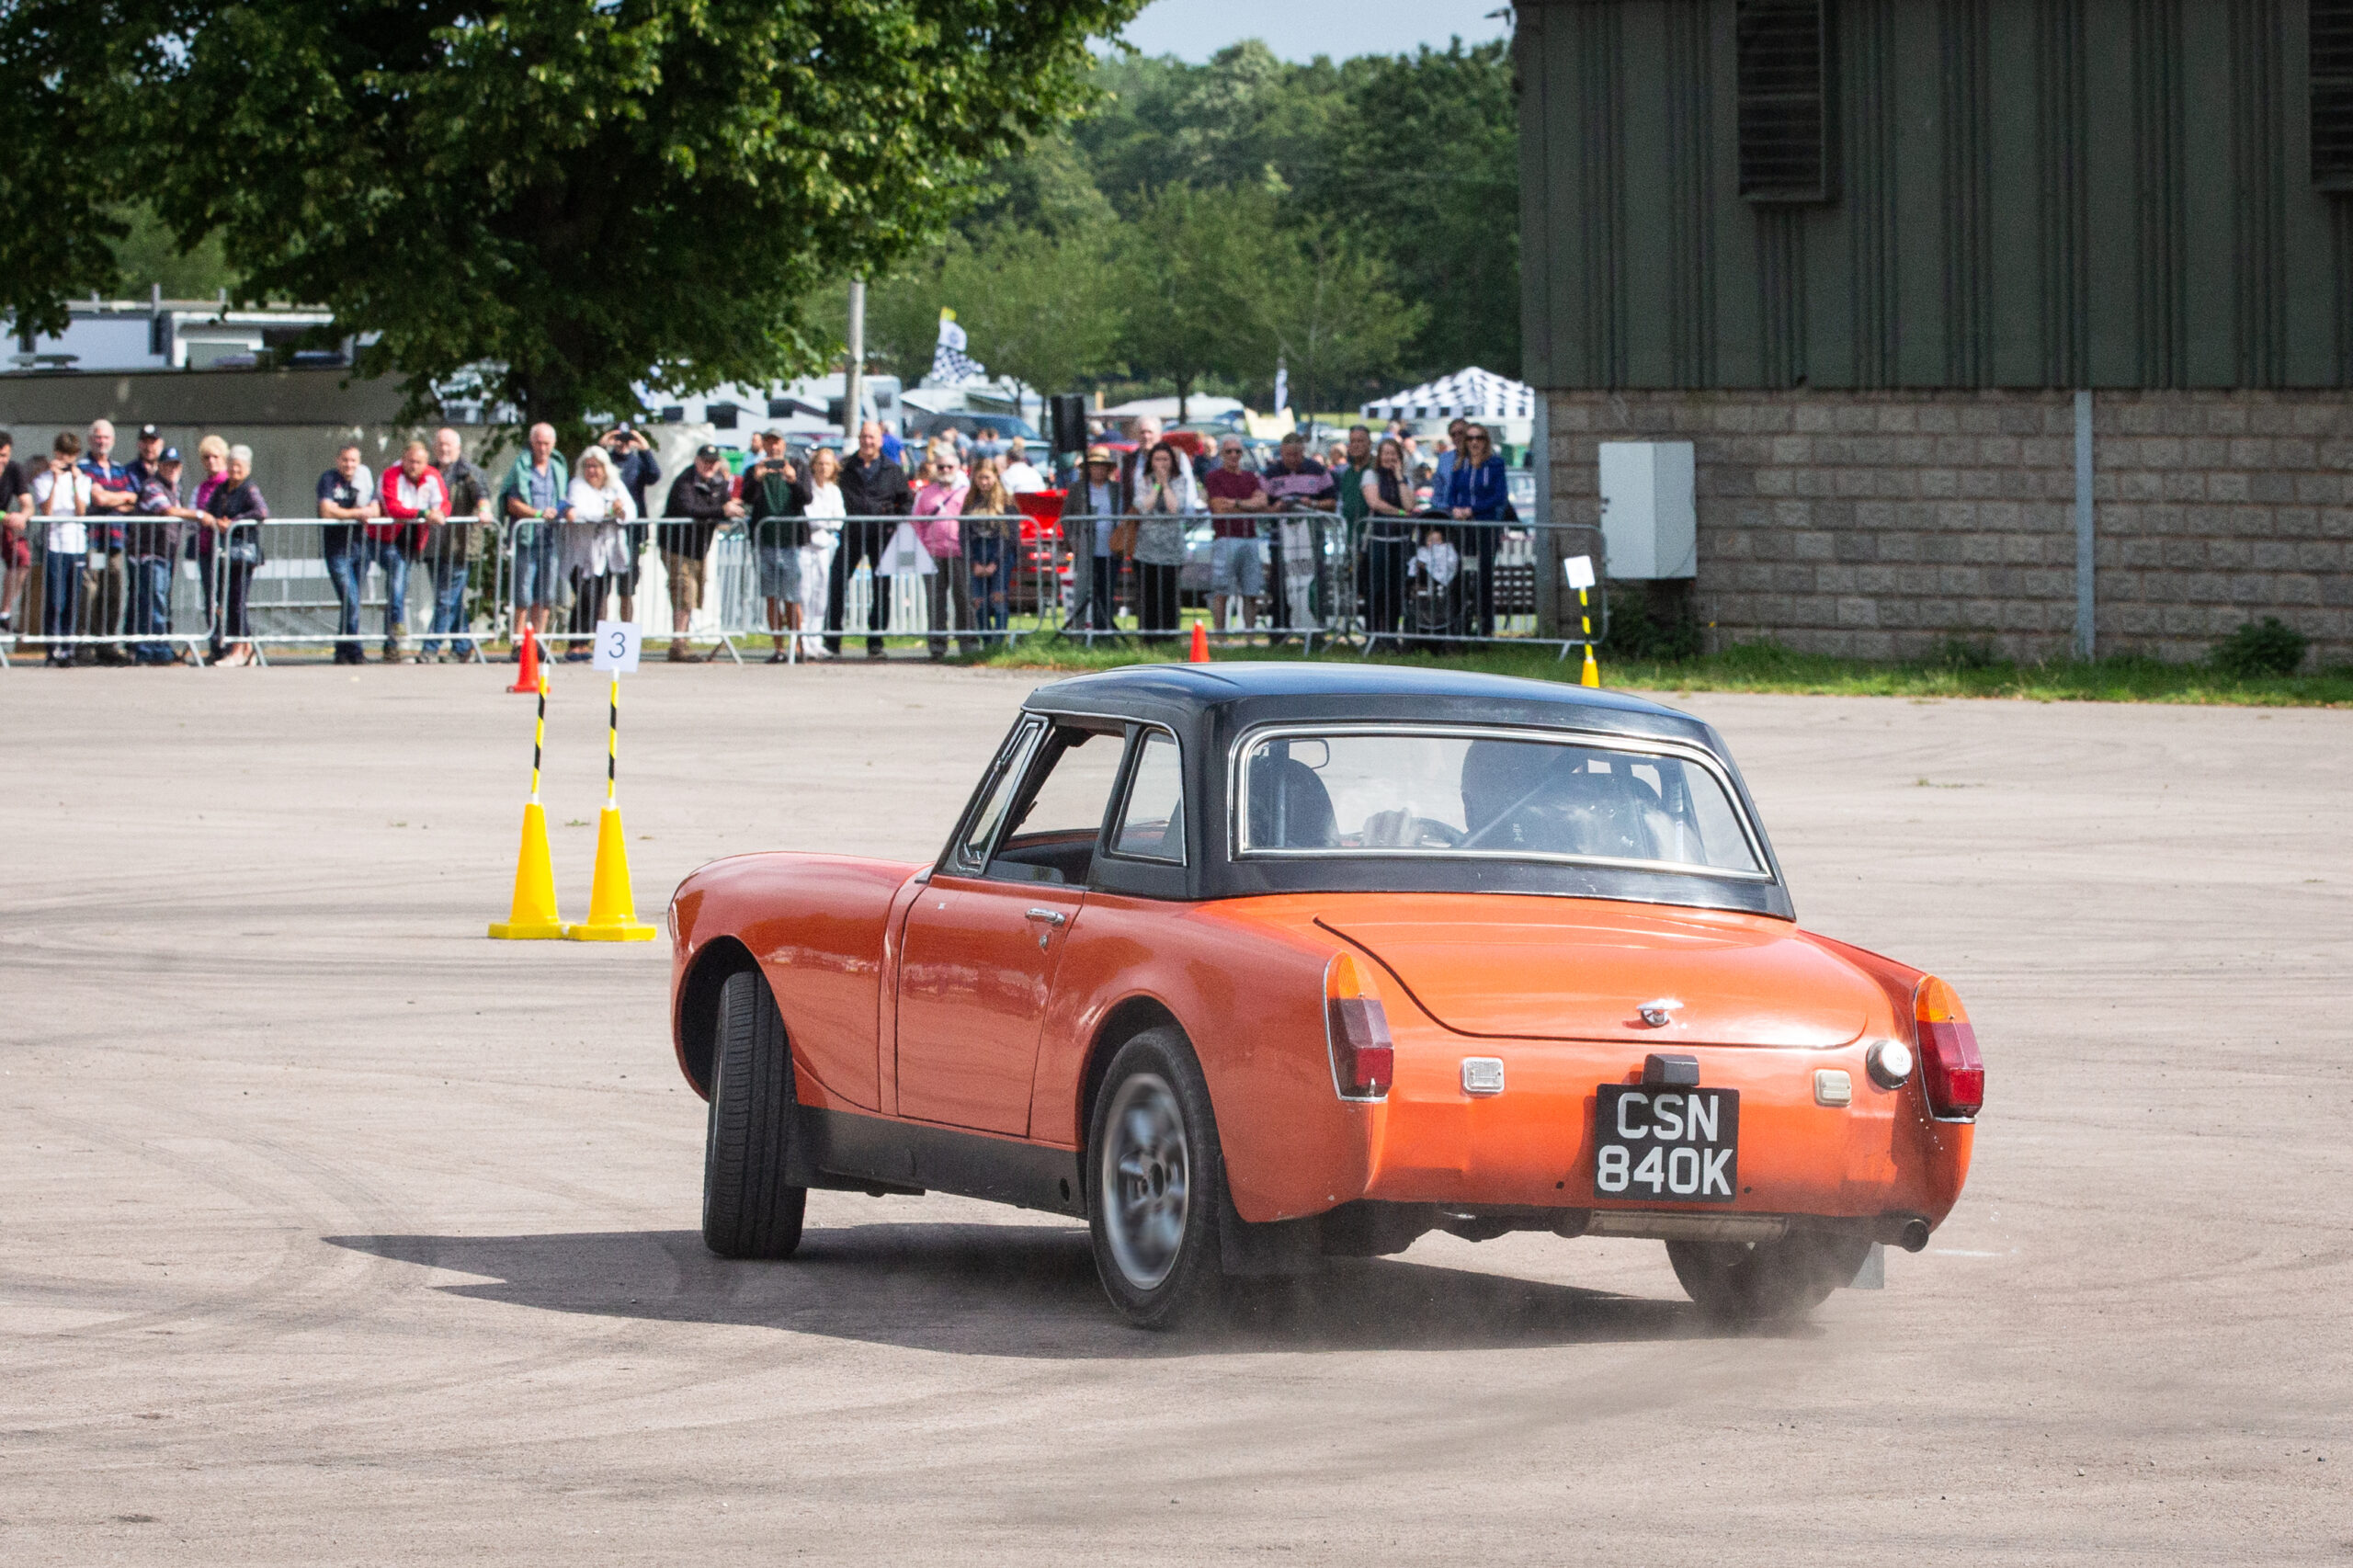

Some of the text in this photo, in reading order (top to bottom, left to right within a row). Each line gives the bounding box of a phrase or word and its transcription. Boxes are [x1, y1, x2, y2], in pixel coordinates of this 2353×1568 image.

[608, 631, 626, 659] 3
[1617, 1092, 1719, 1142] CSN
[1597, 1144, 1733, 1196] 840K
